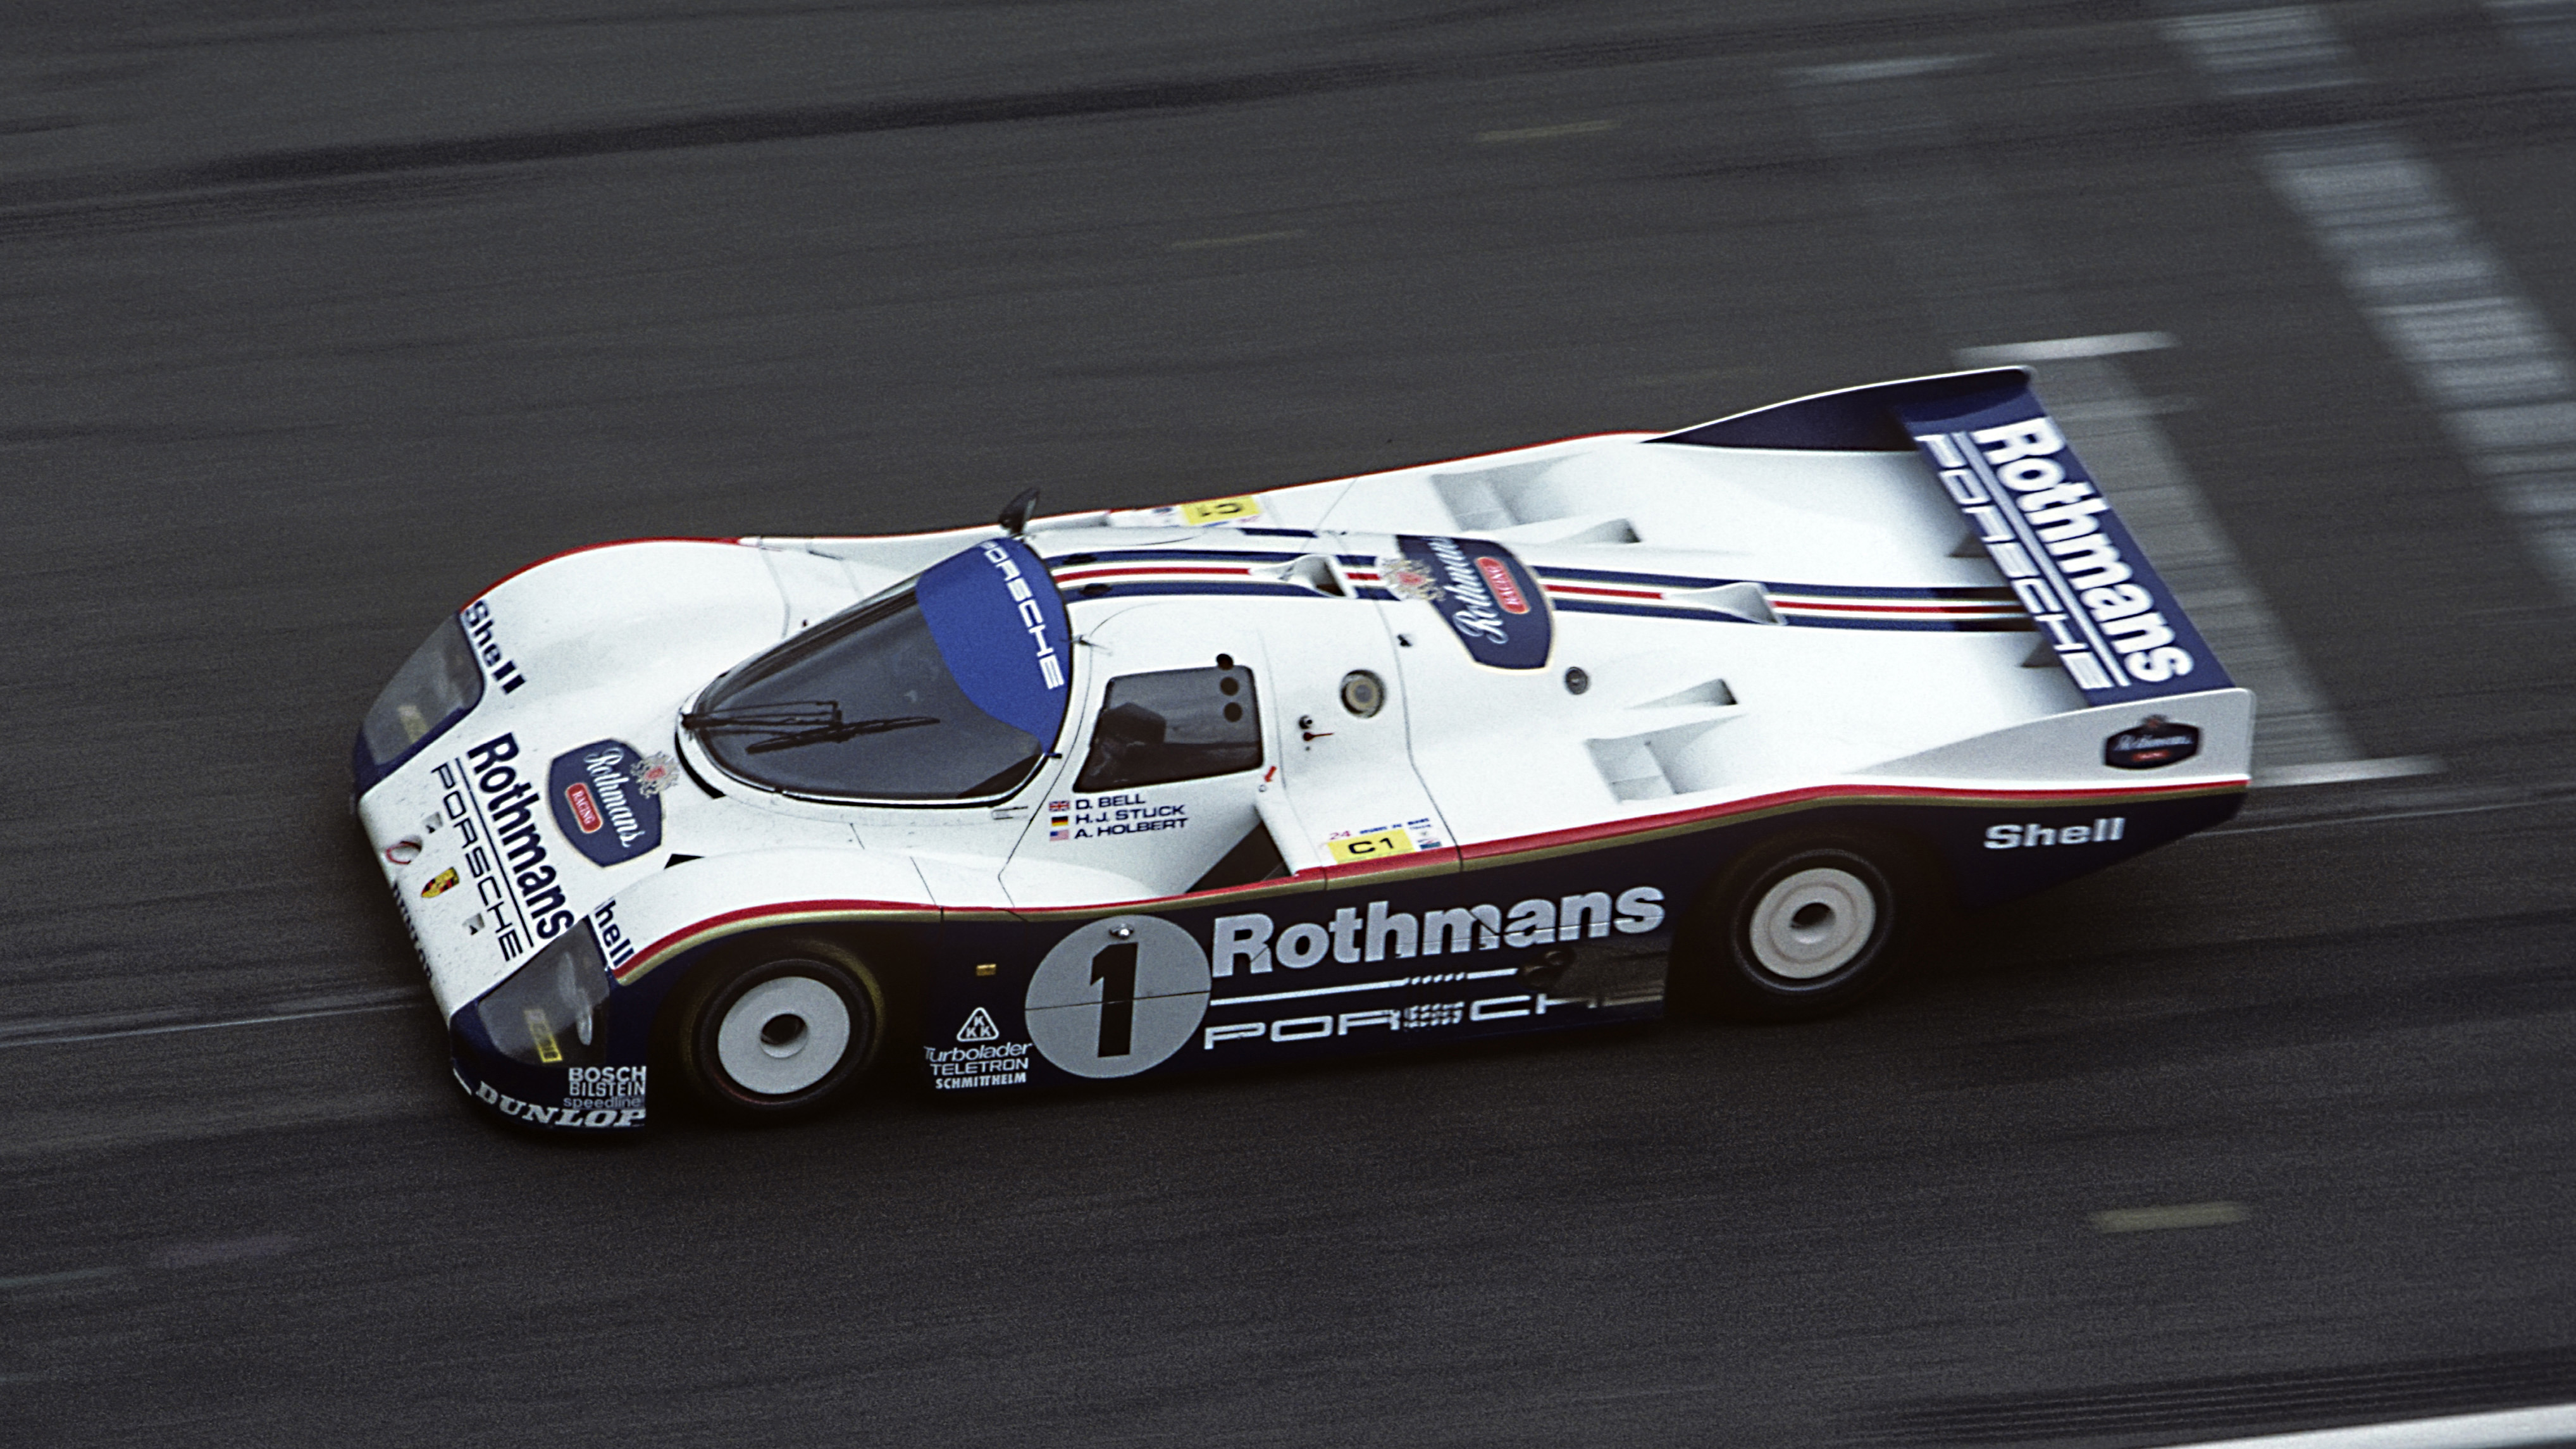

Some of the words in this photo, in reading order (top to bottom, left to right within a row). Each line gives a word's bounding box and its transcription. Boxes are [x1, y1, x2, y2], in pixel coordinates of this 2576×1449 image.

[1913, 433, 2115, 690] PORSCHE
[1970, 416, 2194, 683] Rothmans
[465, 600, 526, 695] Shell
[572, 790, 596, 824] RACING
[583, 748, 646, 847] Rothmans
[1075, 799, 1093, 810] D.
[1098, 793, 1146, 807] BELL
[1115, 804, 1186, 821] STUCK
[467, 732, 575, 940] Rothmans
[1074, 828, 1093, 839] A.
[1098, 818, 1189, 836] HOLBERT
[1983, 817, 2126, 849] Shell
[431, 761, 524, 962] PORSCHE
[594, 896, 635, 968] hell
[1211, 886, 1666, 979] Rothmans
[1089, 942, 1139, 1059] 1
[923, 1042, 1033, 1062] Turbolader
[929, 1057, 1029, 1076] TELETRON
[568, 1066, 647, 1083] BOSCH
[569, 1081, 647, 1097] BILSTEIN
[935, 1072, 1027, 1090] SCHMITTHELM
[475, 1080, 646, 1128] DUNLOP
[562, 1096, 642, 1111] speedline
